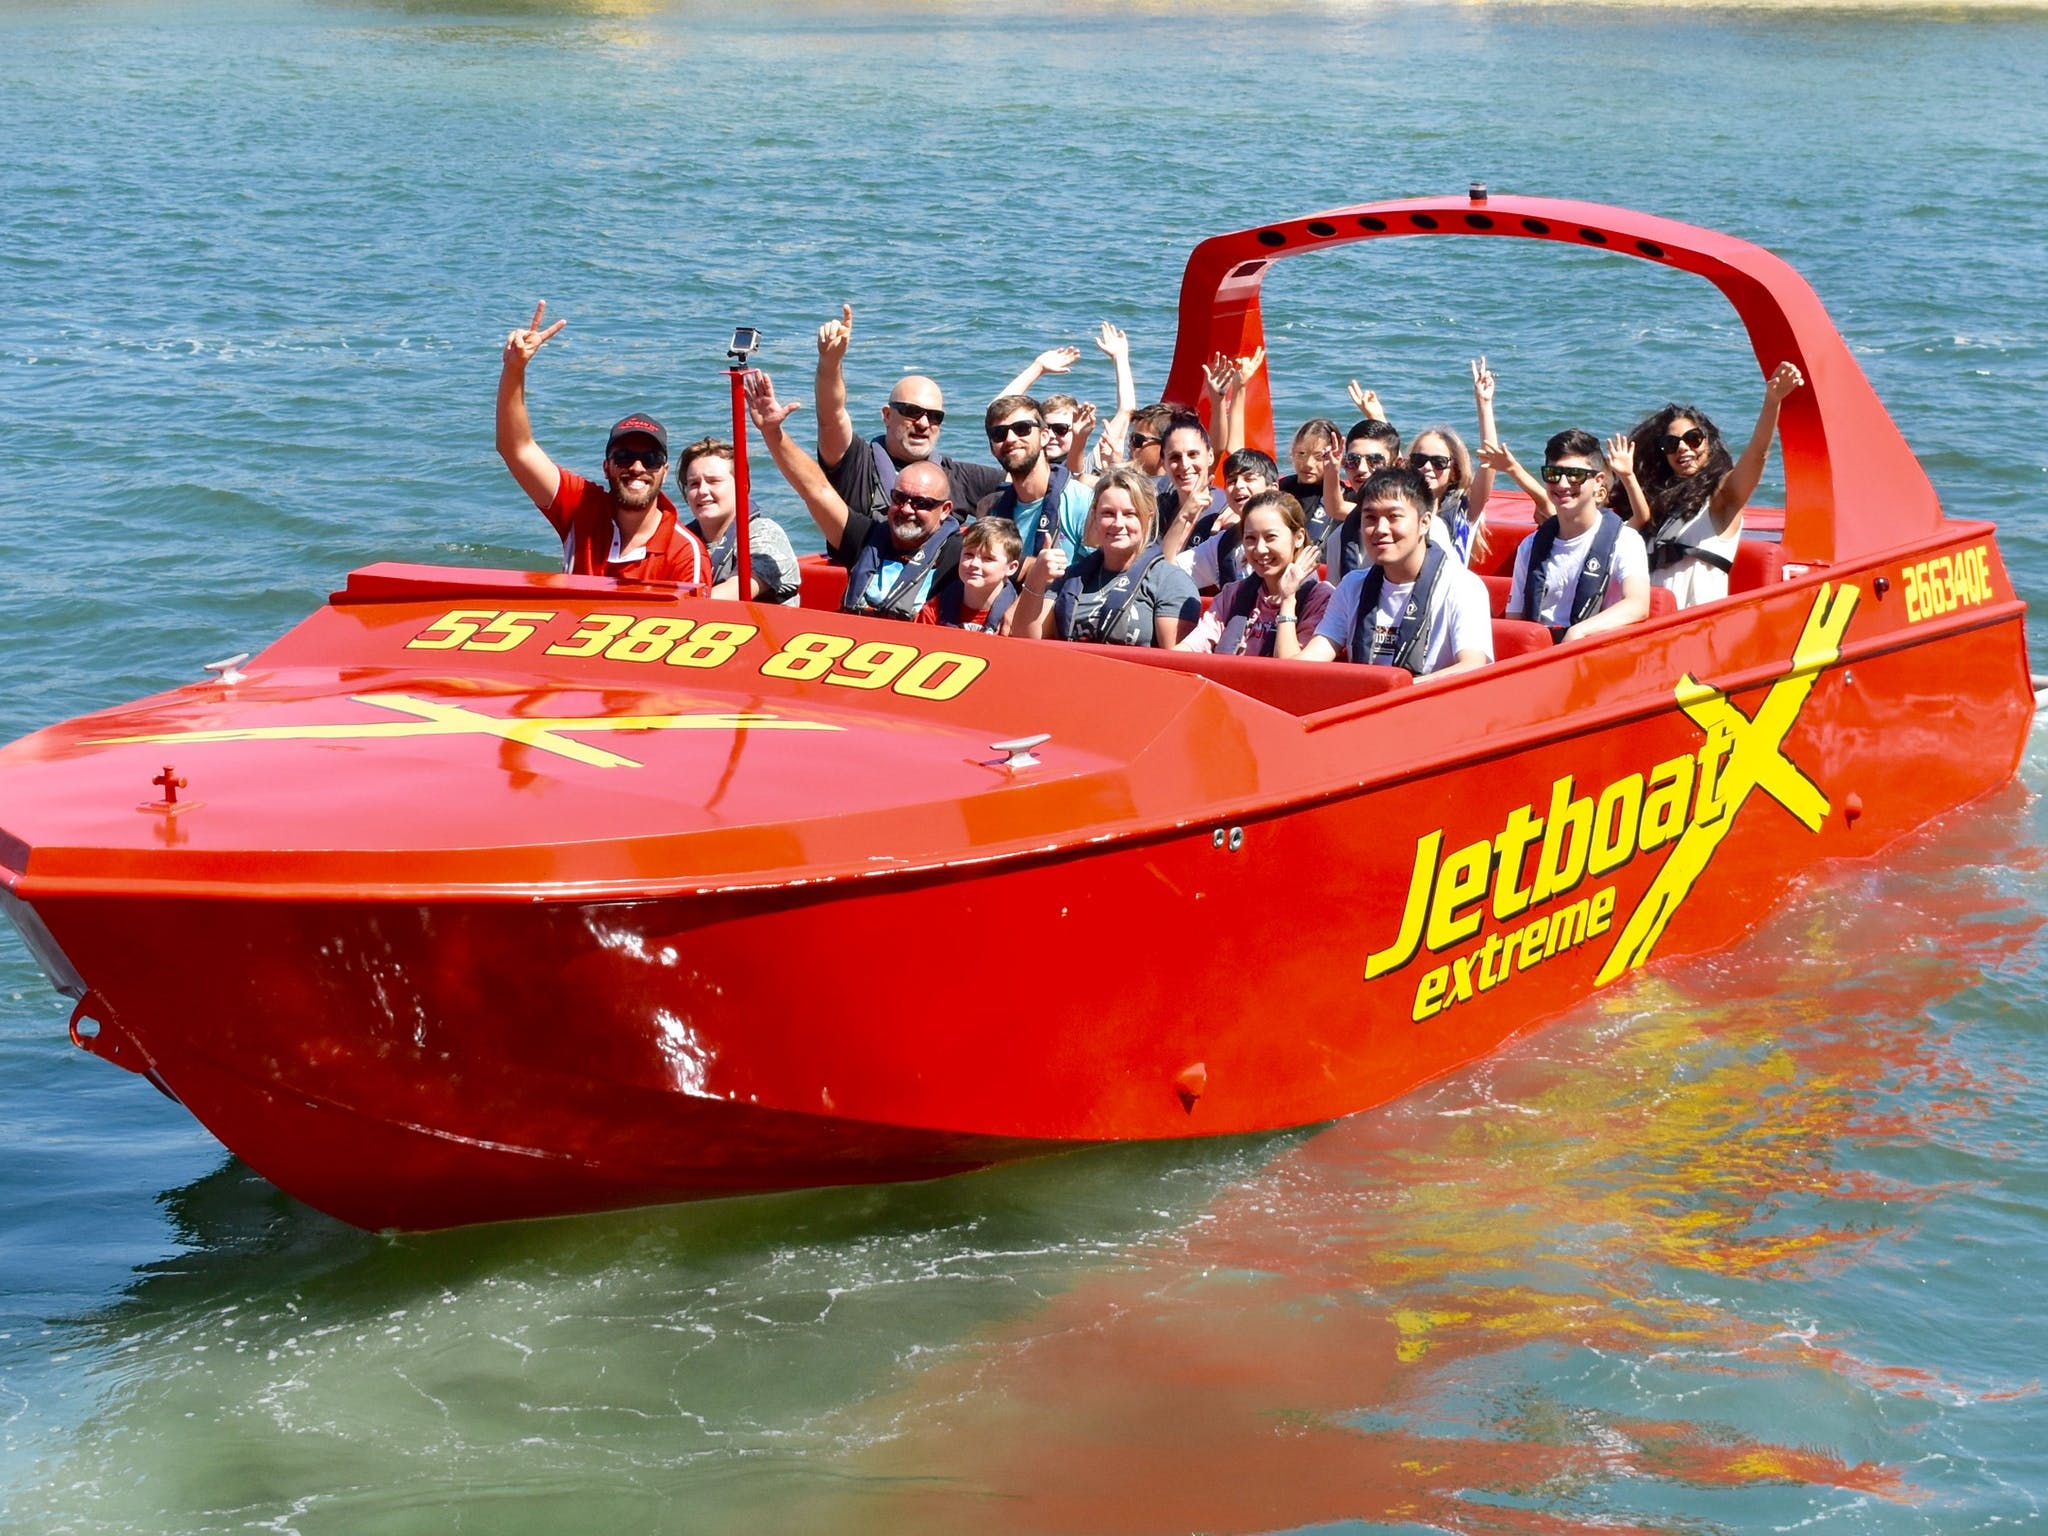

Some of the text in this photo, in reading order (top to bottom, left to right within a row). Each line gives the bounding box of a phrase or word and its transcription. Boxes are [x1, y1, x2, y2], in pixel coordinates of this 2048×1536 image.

[405, 609, 989, 701] 55 388 890
[1363, 718, 1736, 980] Jetboat
[1412, 885, 1617, 1023] extreme
